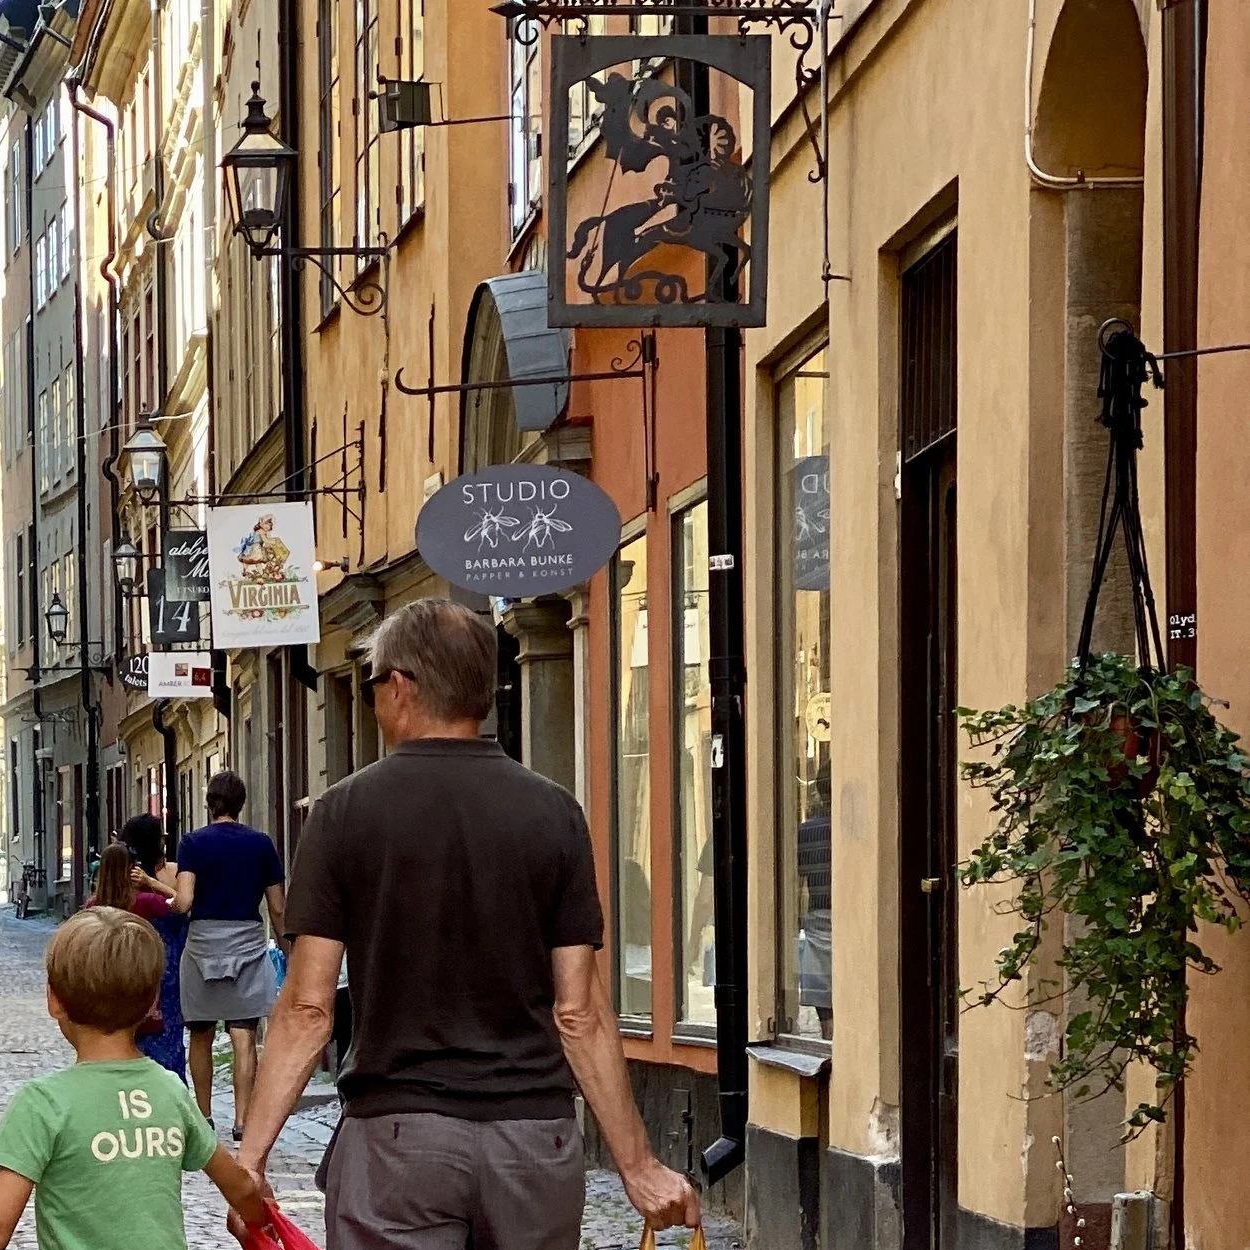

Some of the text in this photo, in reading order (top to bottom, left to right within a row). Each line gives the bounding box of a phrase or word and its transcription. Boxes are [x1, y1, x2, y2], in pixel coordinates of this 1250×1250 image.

[462, 479, 570, 504] STUDIO
[465, 554, 573, 570] BARBARA BUNKE
[466, 571, 510, 581] PAPPER
[533, 567, 573, 577] KONST
[228, 580, 301, 609] VIRGINIA
[155, 595, 191, 634] 14
[118, 1089, 152, 1119] IS
[91, 1126, 183, 1161] OURS
